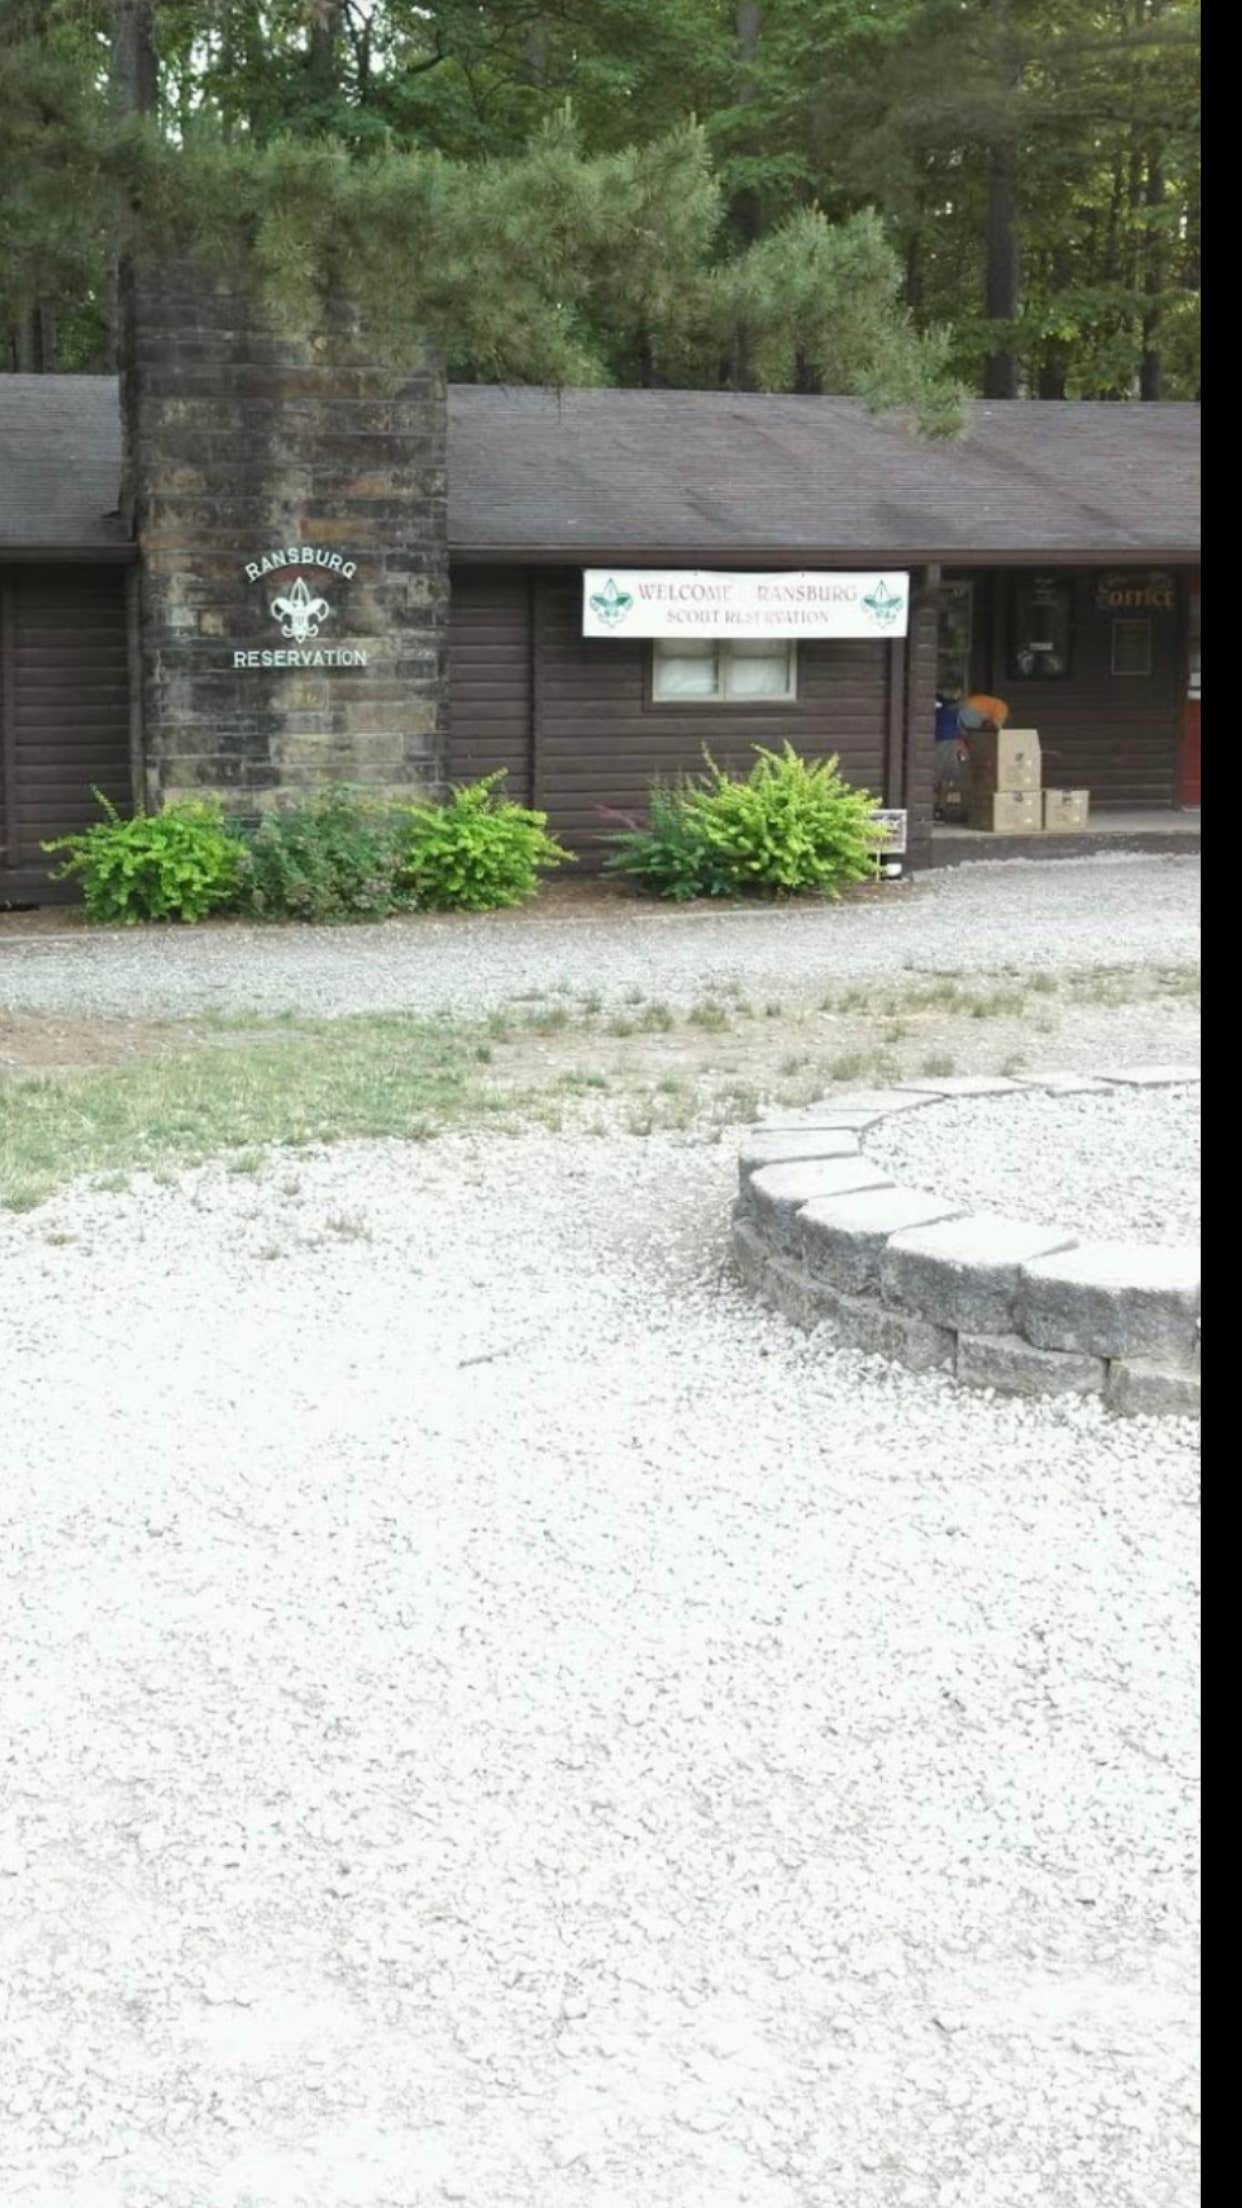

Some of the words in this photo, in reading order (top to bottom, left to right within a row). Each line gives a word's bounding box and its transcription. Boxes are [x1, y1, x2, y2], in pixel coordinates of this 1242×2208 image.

[245, 547, 357, 583] RANSBURG
[638, 584, 733, 601] WELCOME
[757, 585, 857, 602] RANSBURG
[666, 609, 719, 624] SCOUT
[233, 650, 368, 668] RESERVATION
